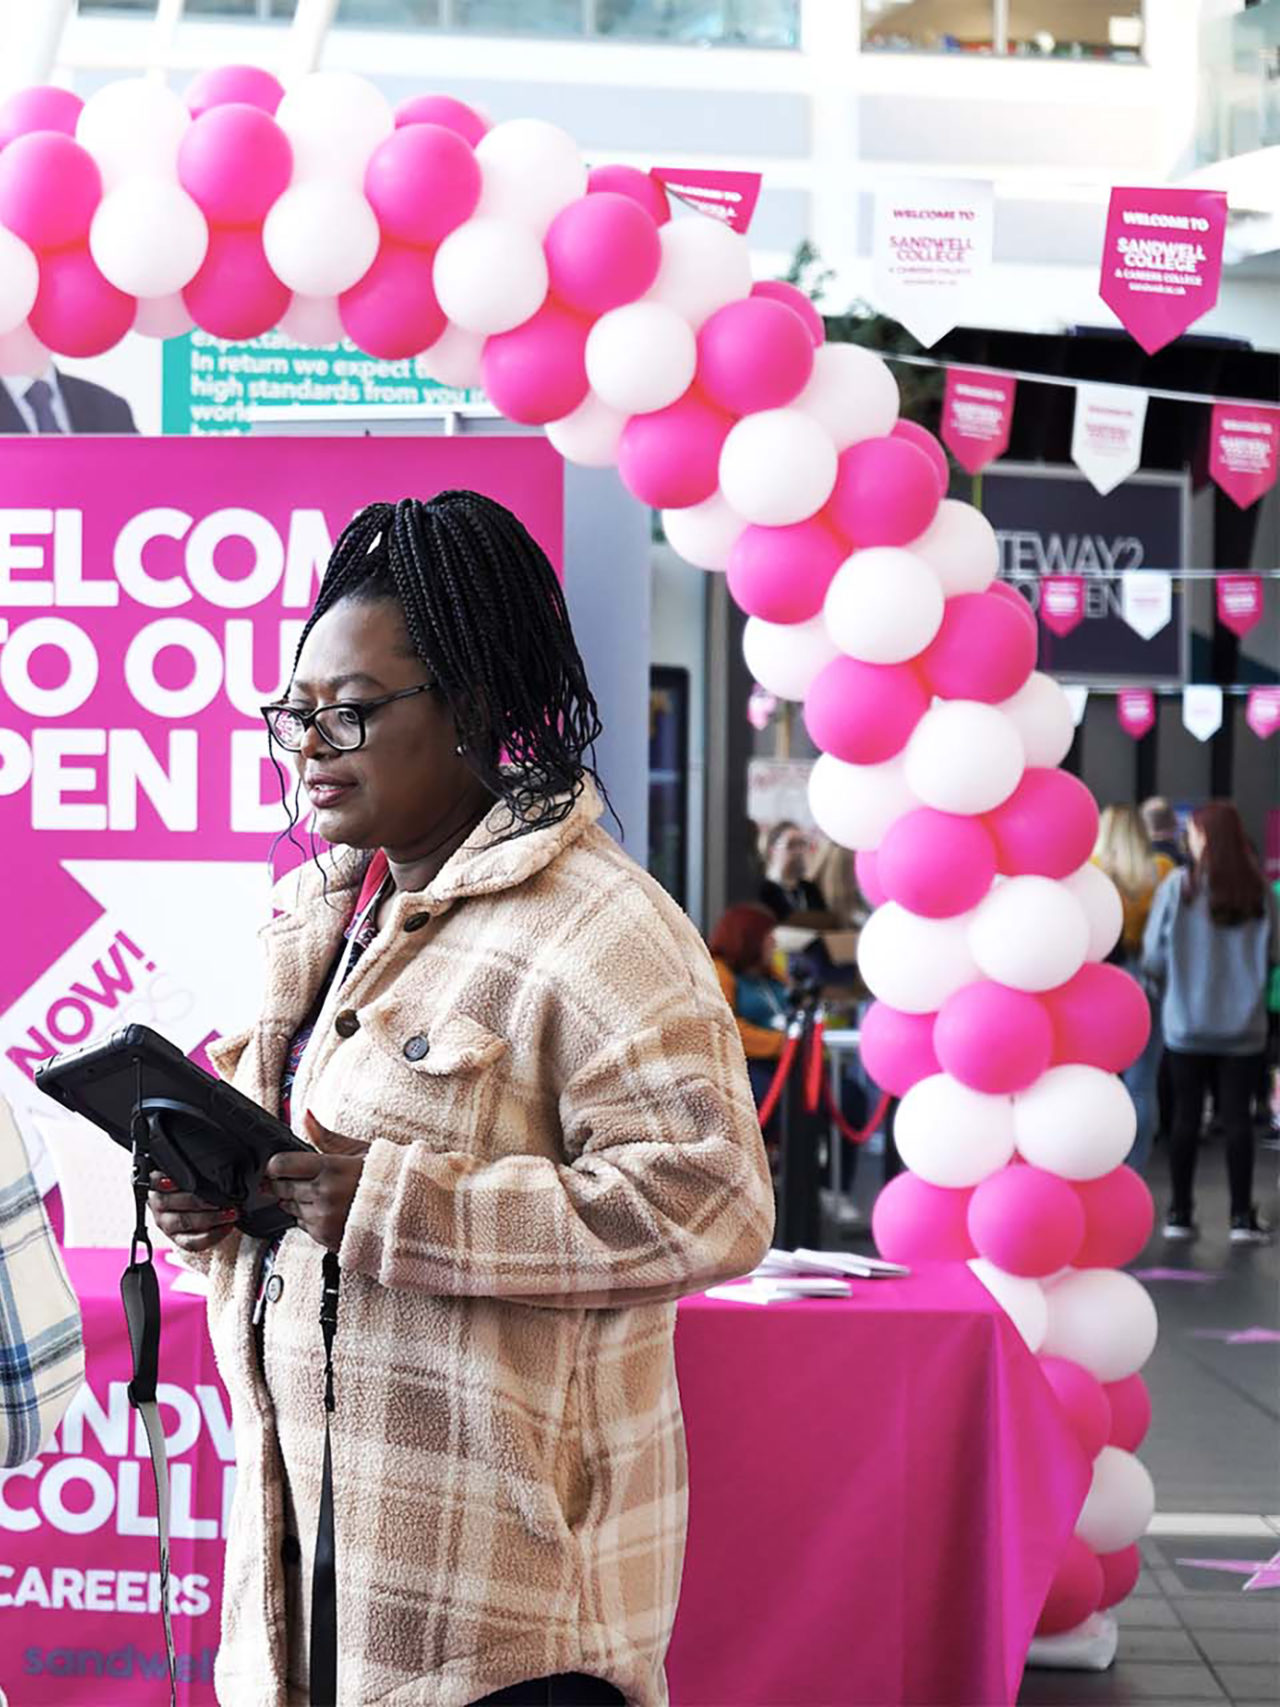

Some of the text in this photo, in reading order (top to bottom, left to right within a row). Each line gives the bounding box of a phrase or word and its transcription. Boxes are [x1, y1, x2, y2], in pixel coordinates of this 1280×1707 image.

[1122, 210, 1210, 232] WELCOME TO
[889, 235, 974, 250] SANDWELL
[1116, 236, 1207, 261] SANDWELL
[1123, 251, 1198, 273] COLLEGE
[191, 351, 215, 371] In
[218, 354, 289, 373] return
[292, 359, 329, 376] we
[191, 374, 244, 403] high
[248, 378, 361, 402] standards
[363, 380, 419, 404] from
[230, 728, 322, 832] D
[5, 929, 157, 1083] NOW!
